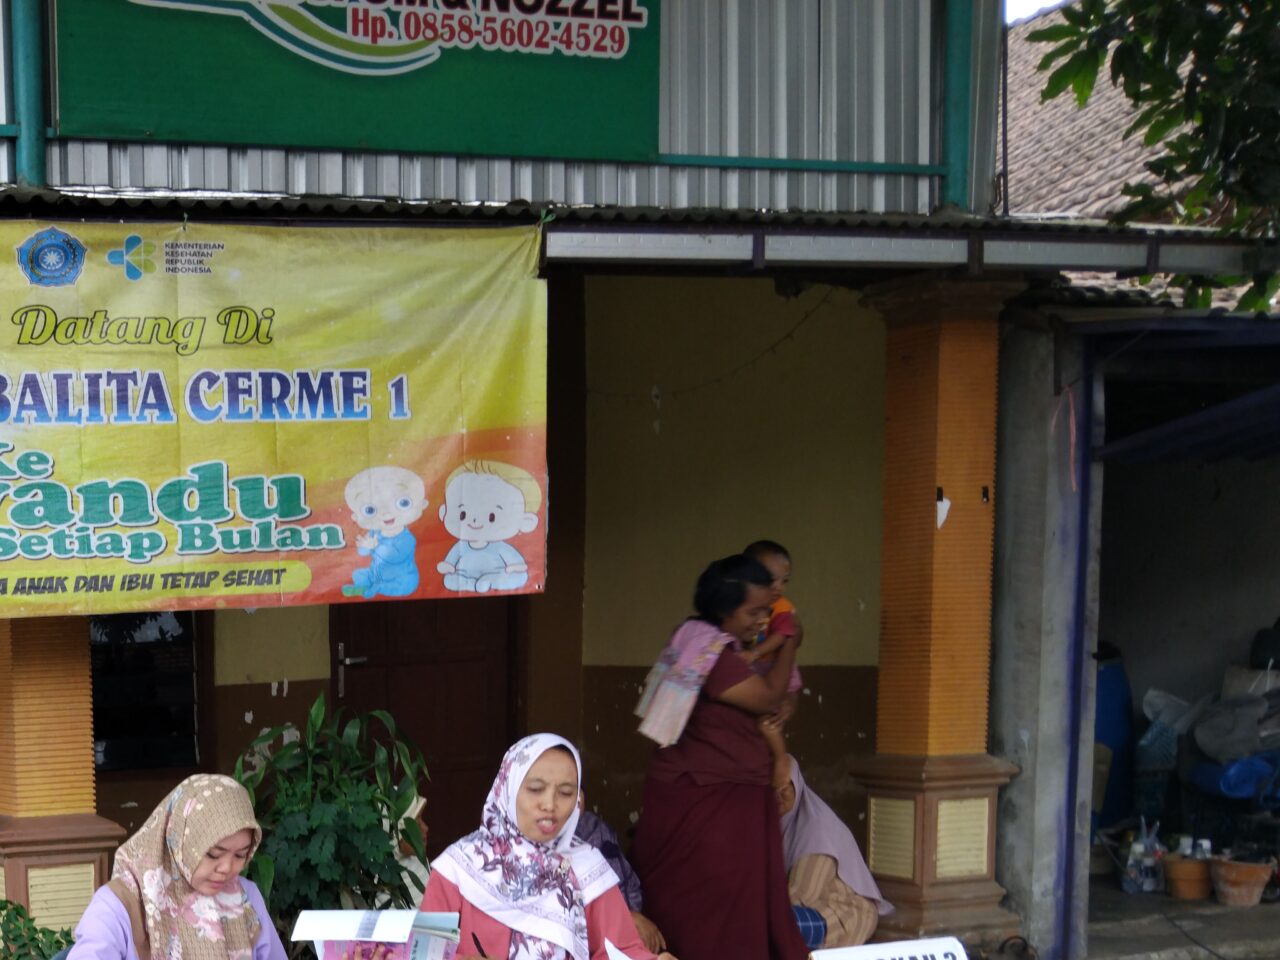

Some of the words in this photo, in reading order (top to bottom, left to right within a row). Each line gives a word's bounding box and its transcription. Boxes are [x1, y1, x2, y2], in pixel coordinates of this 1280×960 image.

[351, 7, 395, 44] Hp.
[403, 11, 626, 54] 0858-5602-4529
[164, 242, 225, 250] KEMENTERIAN
[11, 304, 206, 356] Datang
[216, 305, 276, 345] Di
[186, 369, 371, 423] CERME
[388, 374, 412, 420] 1
[177, 521, 347, 555] Bulan
[12, 576, 69, 595] ANAK
[73, 575, 116, 593] DAN
[120, 573, 155, 591] IBU
[160, 571, 219, 590] TETAP
[222, 568, 287, 588] SEHAT
